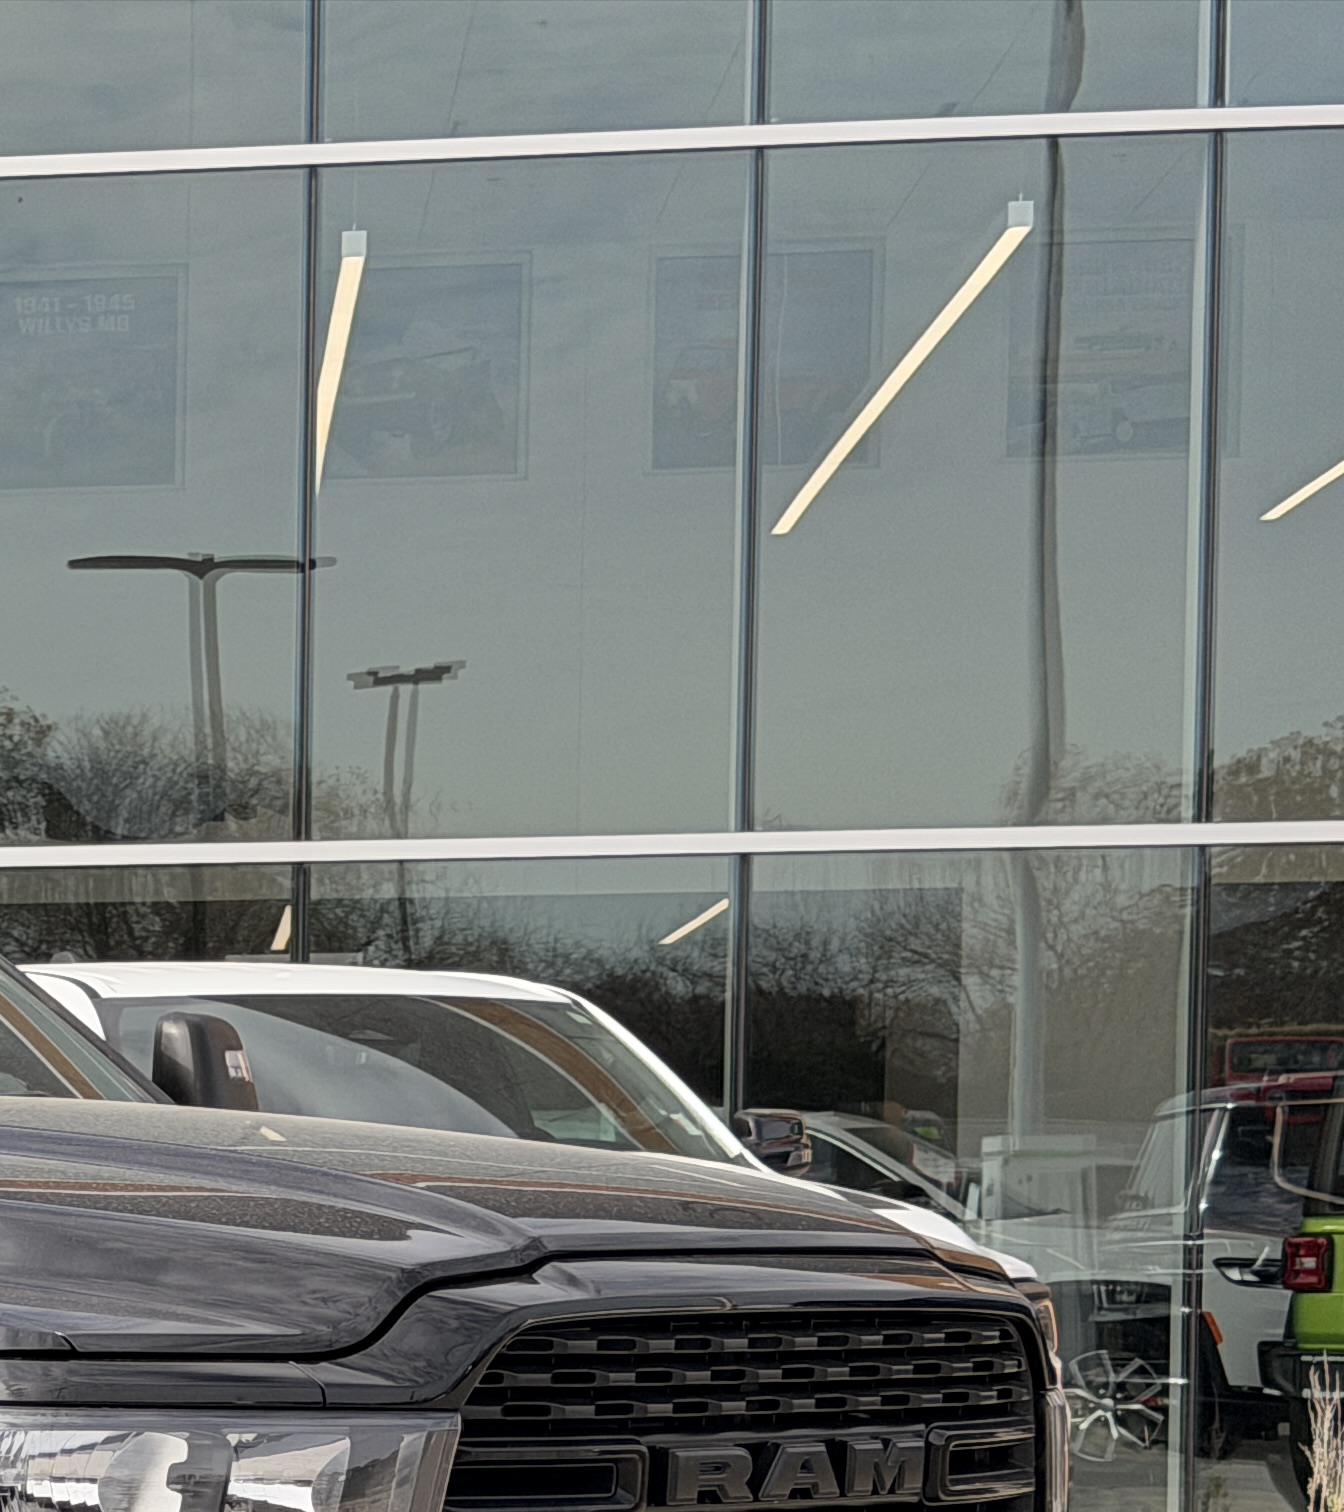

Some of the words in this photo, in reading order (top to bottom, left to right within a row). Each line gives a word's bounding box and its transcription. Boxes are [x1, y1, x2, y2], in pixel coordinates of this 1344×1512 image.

[14, 296, 61, 314] 1941
[83, 293, 136, 313] 1945
[666, 1440, 926, 1505] RAM
